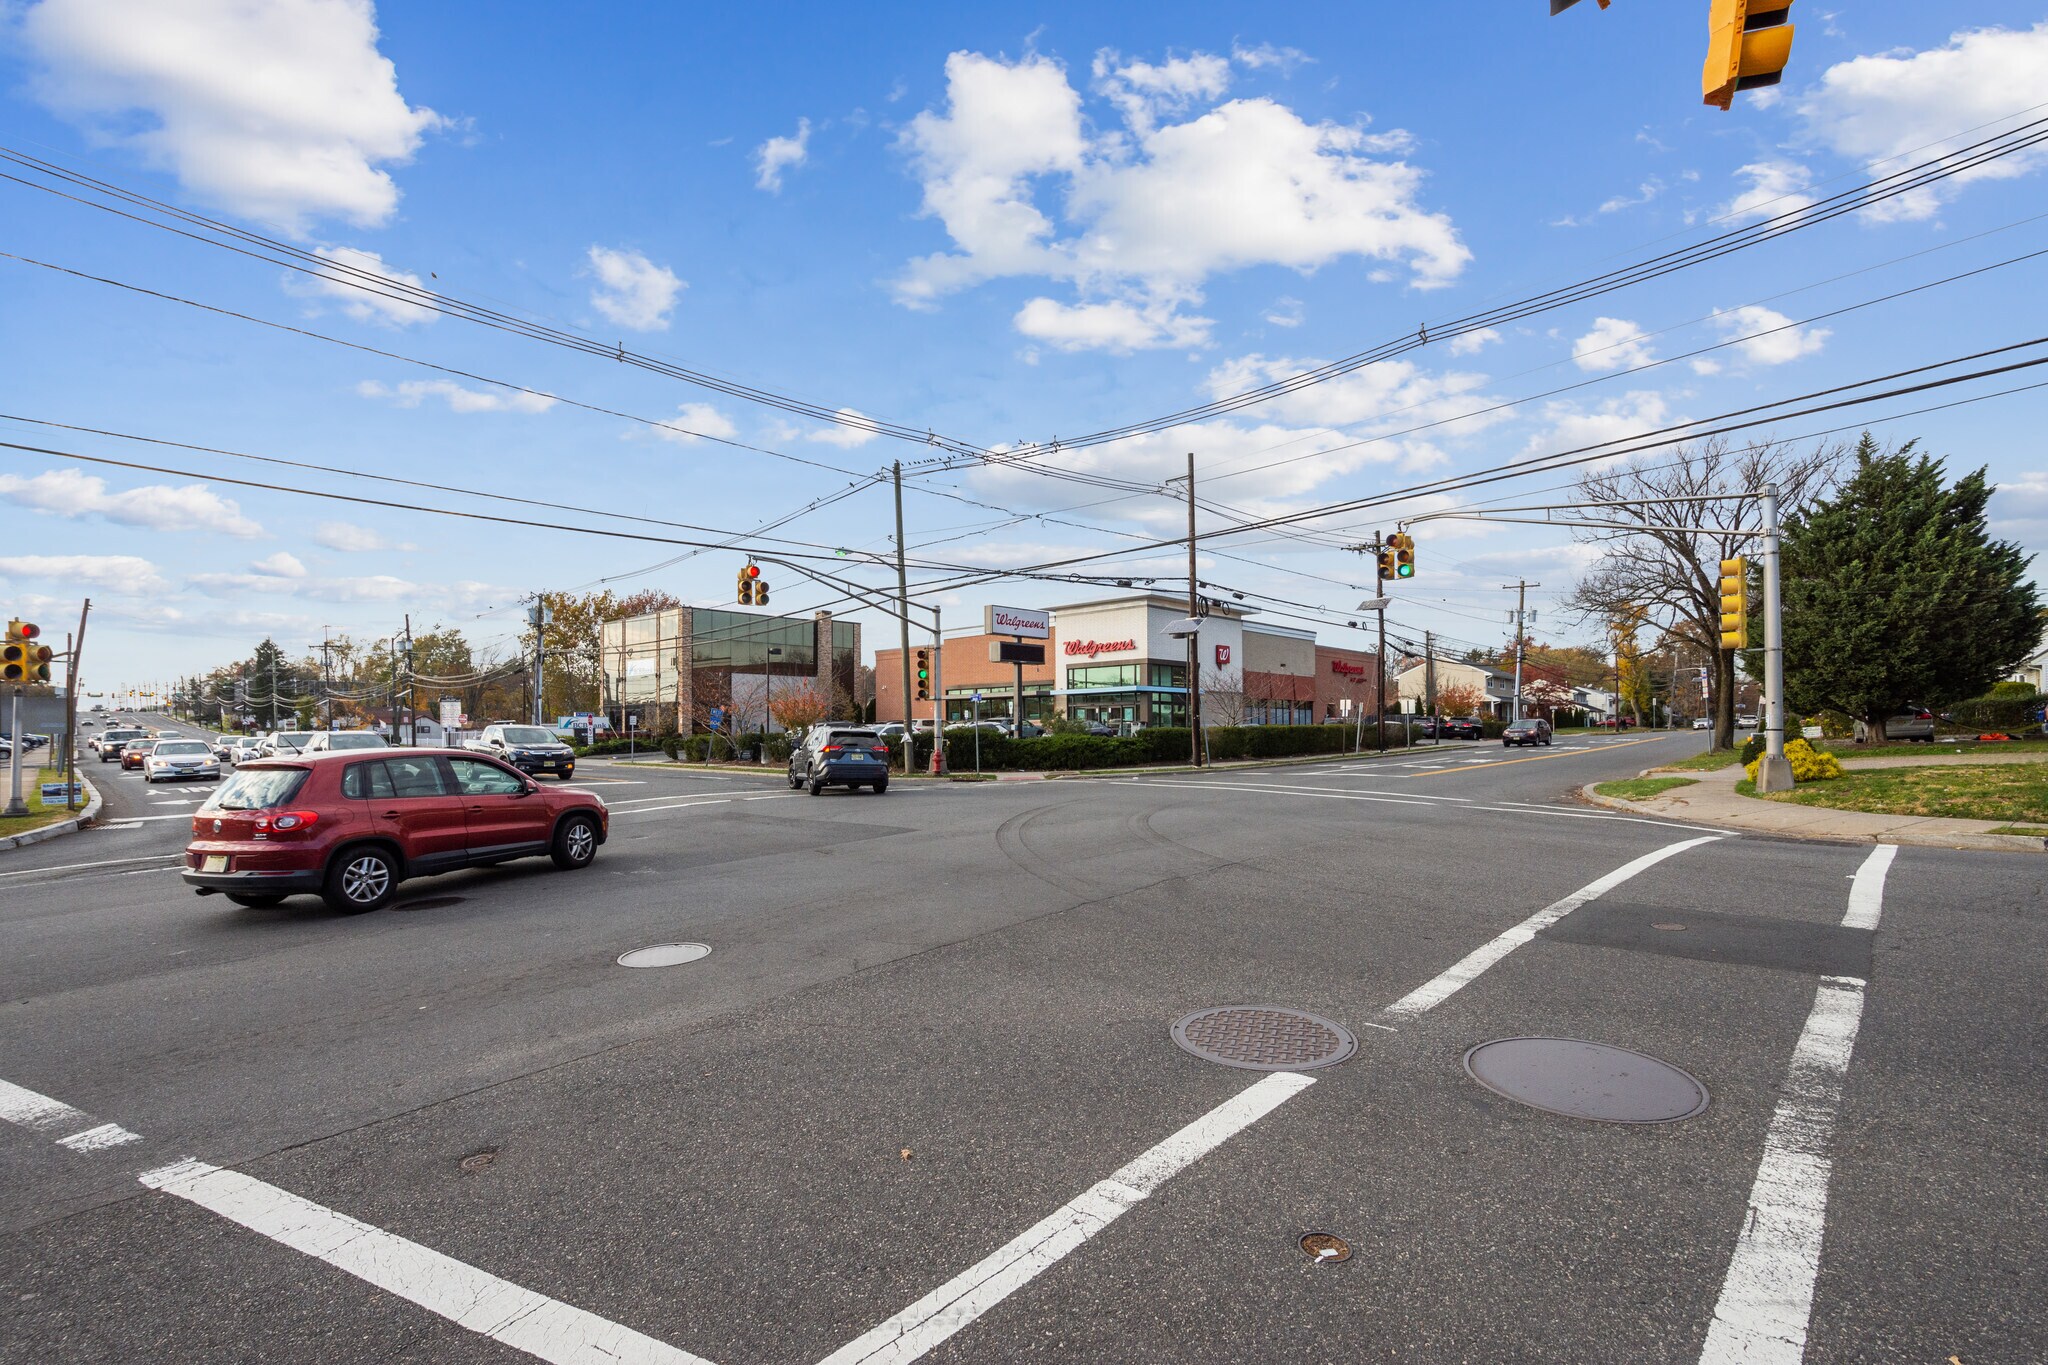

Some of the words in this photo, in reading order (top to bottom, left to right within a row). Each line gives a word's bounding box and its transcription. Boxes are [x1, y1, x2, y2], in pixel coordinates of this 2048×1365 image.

[995, 613, 1046, 630] Walgreens
[1063, 639, 1136, 659] Walgreens
[1218, 648, 1229, 661] W
[1332, 660, 1365, 677] Walgreens
